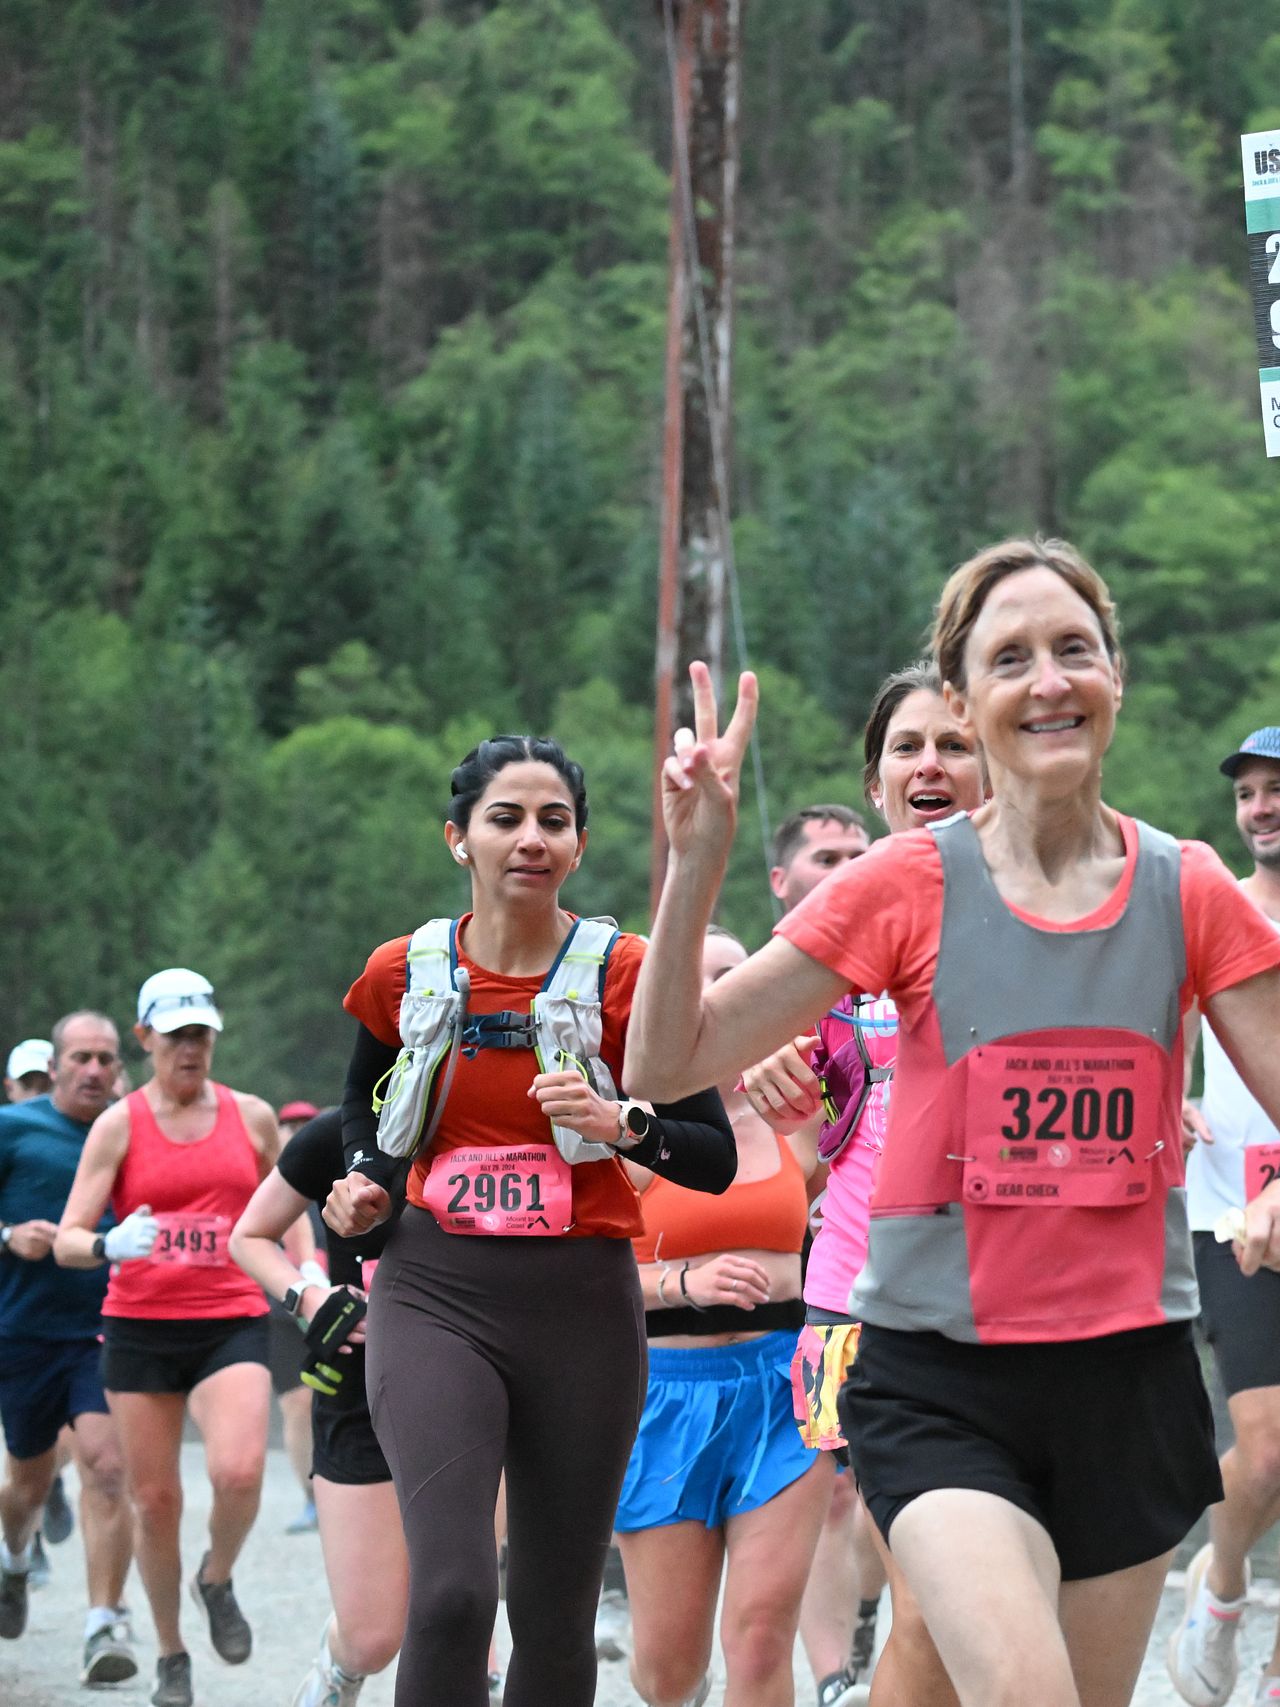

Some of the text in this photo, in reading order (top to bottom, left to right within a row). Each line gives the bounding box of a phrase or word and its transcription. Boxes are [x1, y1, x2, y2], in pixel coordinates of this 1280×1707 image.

[1001, 1087, 1134, 1141] 3200
[468, 1153, 482, 1162] AND
[505, 1152, 547, 1162] MARATHON
[447, 1173, 545, 1213] 2961
[996, 1183, 1060, 1197] GEAR CHECK
[160, 1229, 217, 1253] 3493
